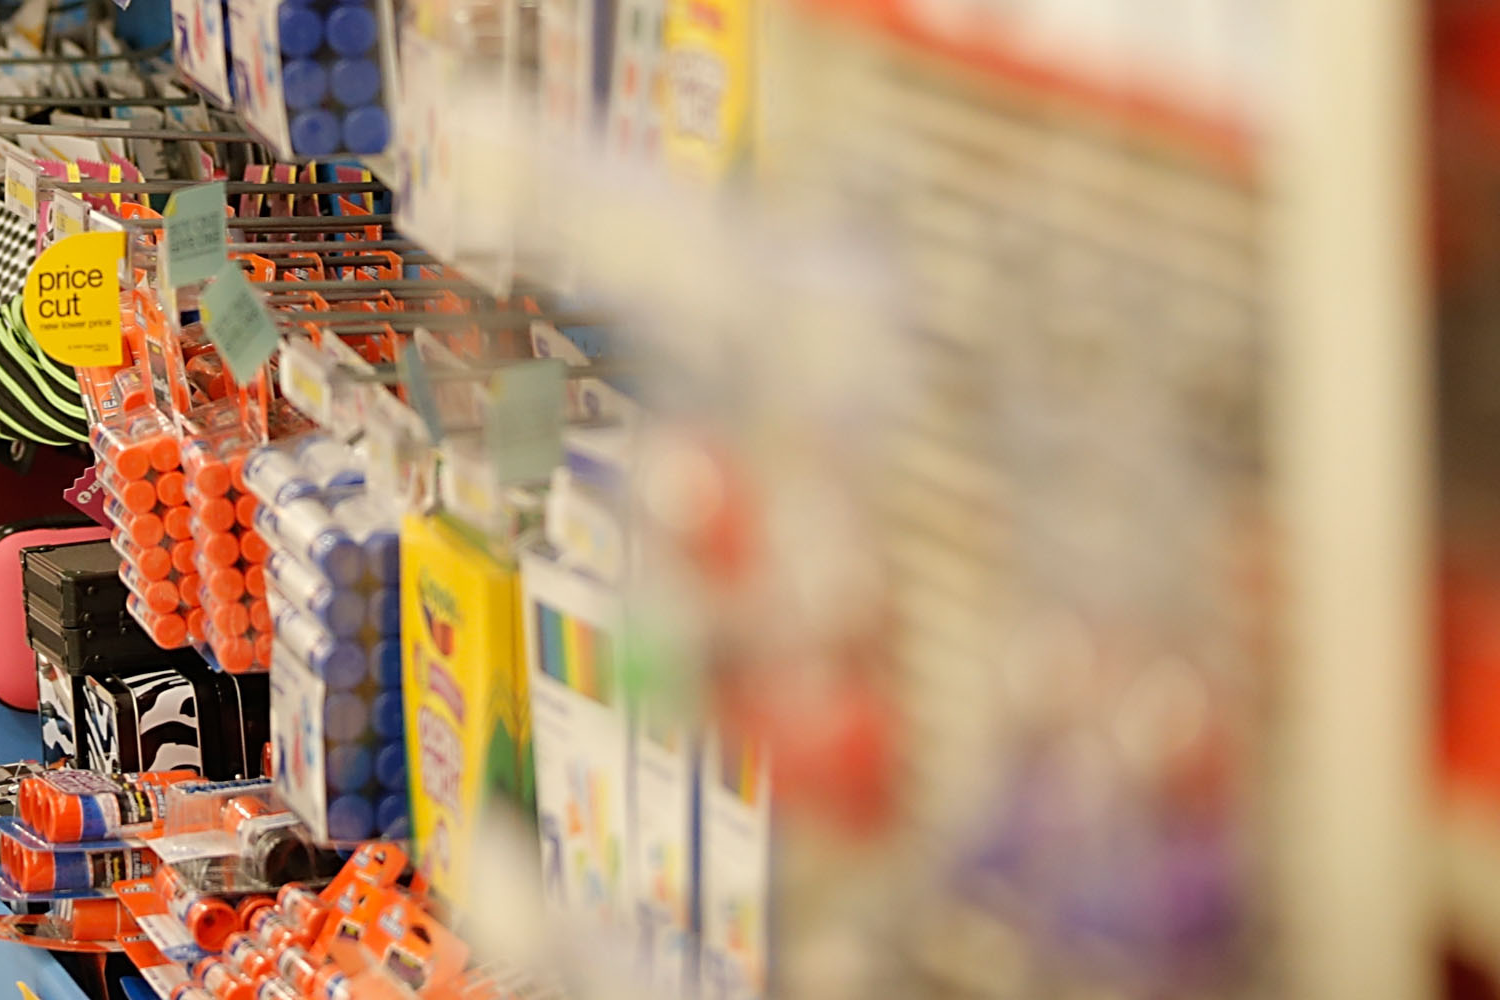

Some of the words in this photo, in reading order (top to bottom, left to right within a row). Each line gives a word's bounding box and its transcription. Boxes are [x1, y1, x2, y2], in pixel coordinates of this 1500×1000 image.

[38, 264, 103, 298] price
[39, 293, 81, 318] cut
[89, 319, 112, 329] price
